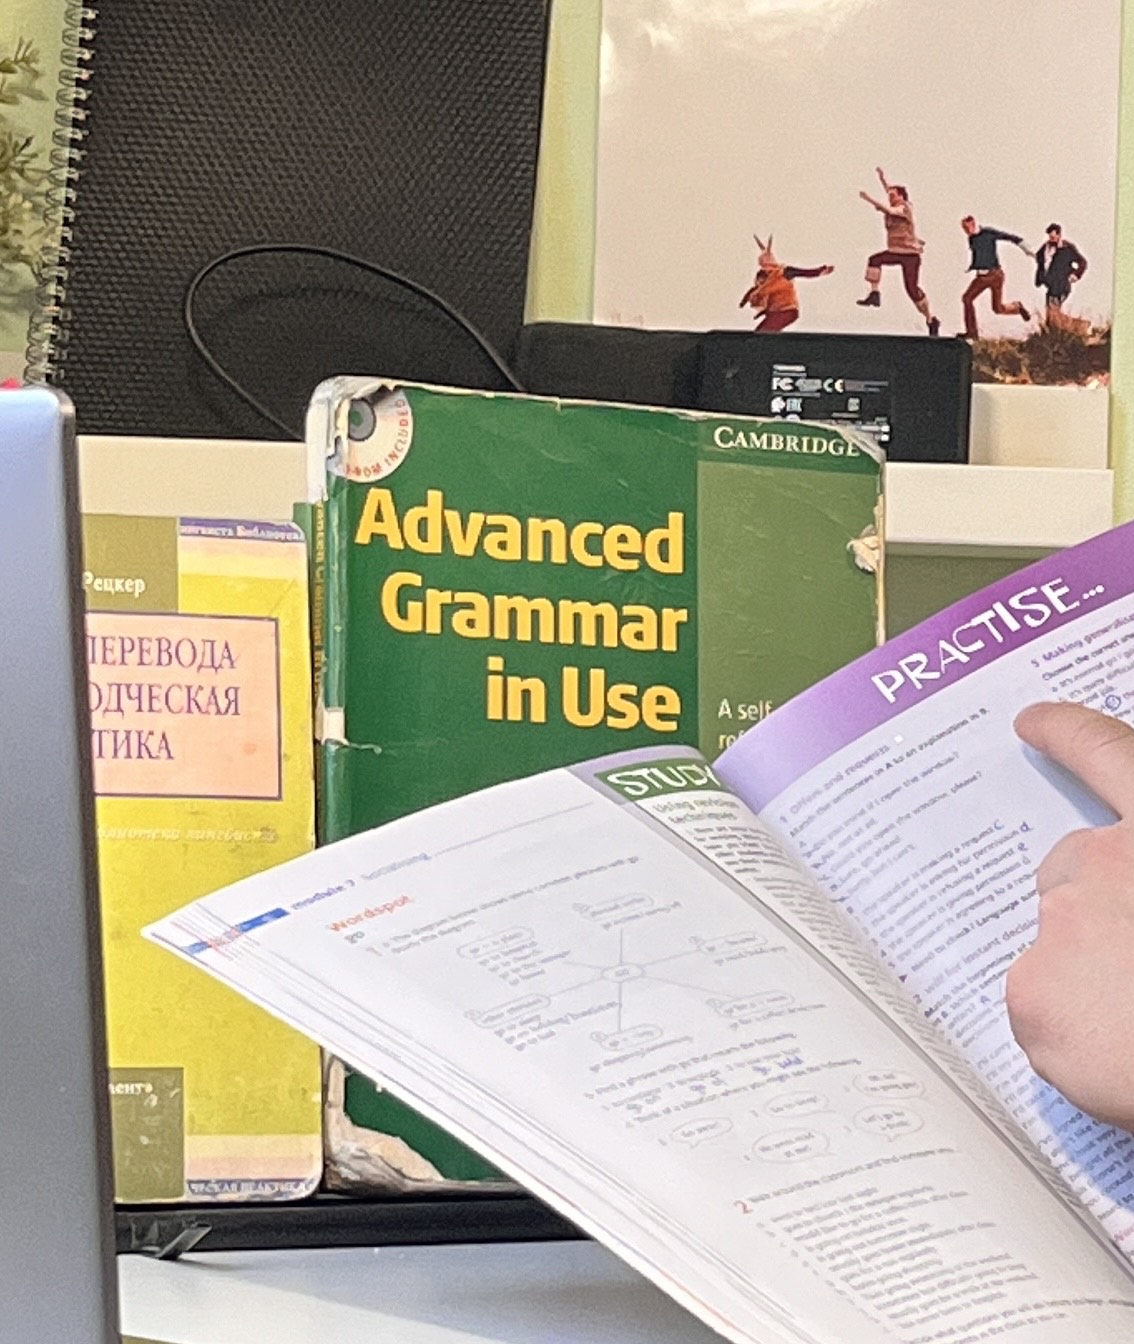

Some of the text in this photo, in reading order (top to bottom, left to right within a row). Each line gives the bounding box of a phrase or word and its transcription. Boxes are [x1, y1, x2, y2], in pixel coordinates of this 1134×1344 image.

[713, 425, 861, 457] CAMBRIDGE
[355, 487, 684, 574] Advanced
[381, 572, 688, 652] Grammar
[1041, 638, 1085, 663] Making
[90, 680, 241, 718] ОДЧЕСКАЯ
[486, 656, 681, 732] in Use
[717, 698, 732, 719] A
[92, 728, 175, 761] ТИКА
[823, 772, 844, 791] and
[844, 745, 890, 776] requests
[328, 895, 411, 933] Wordspot
